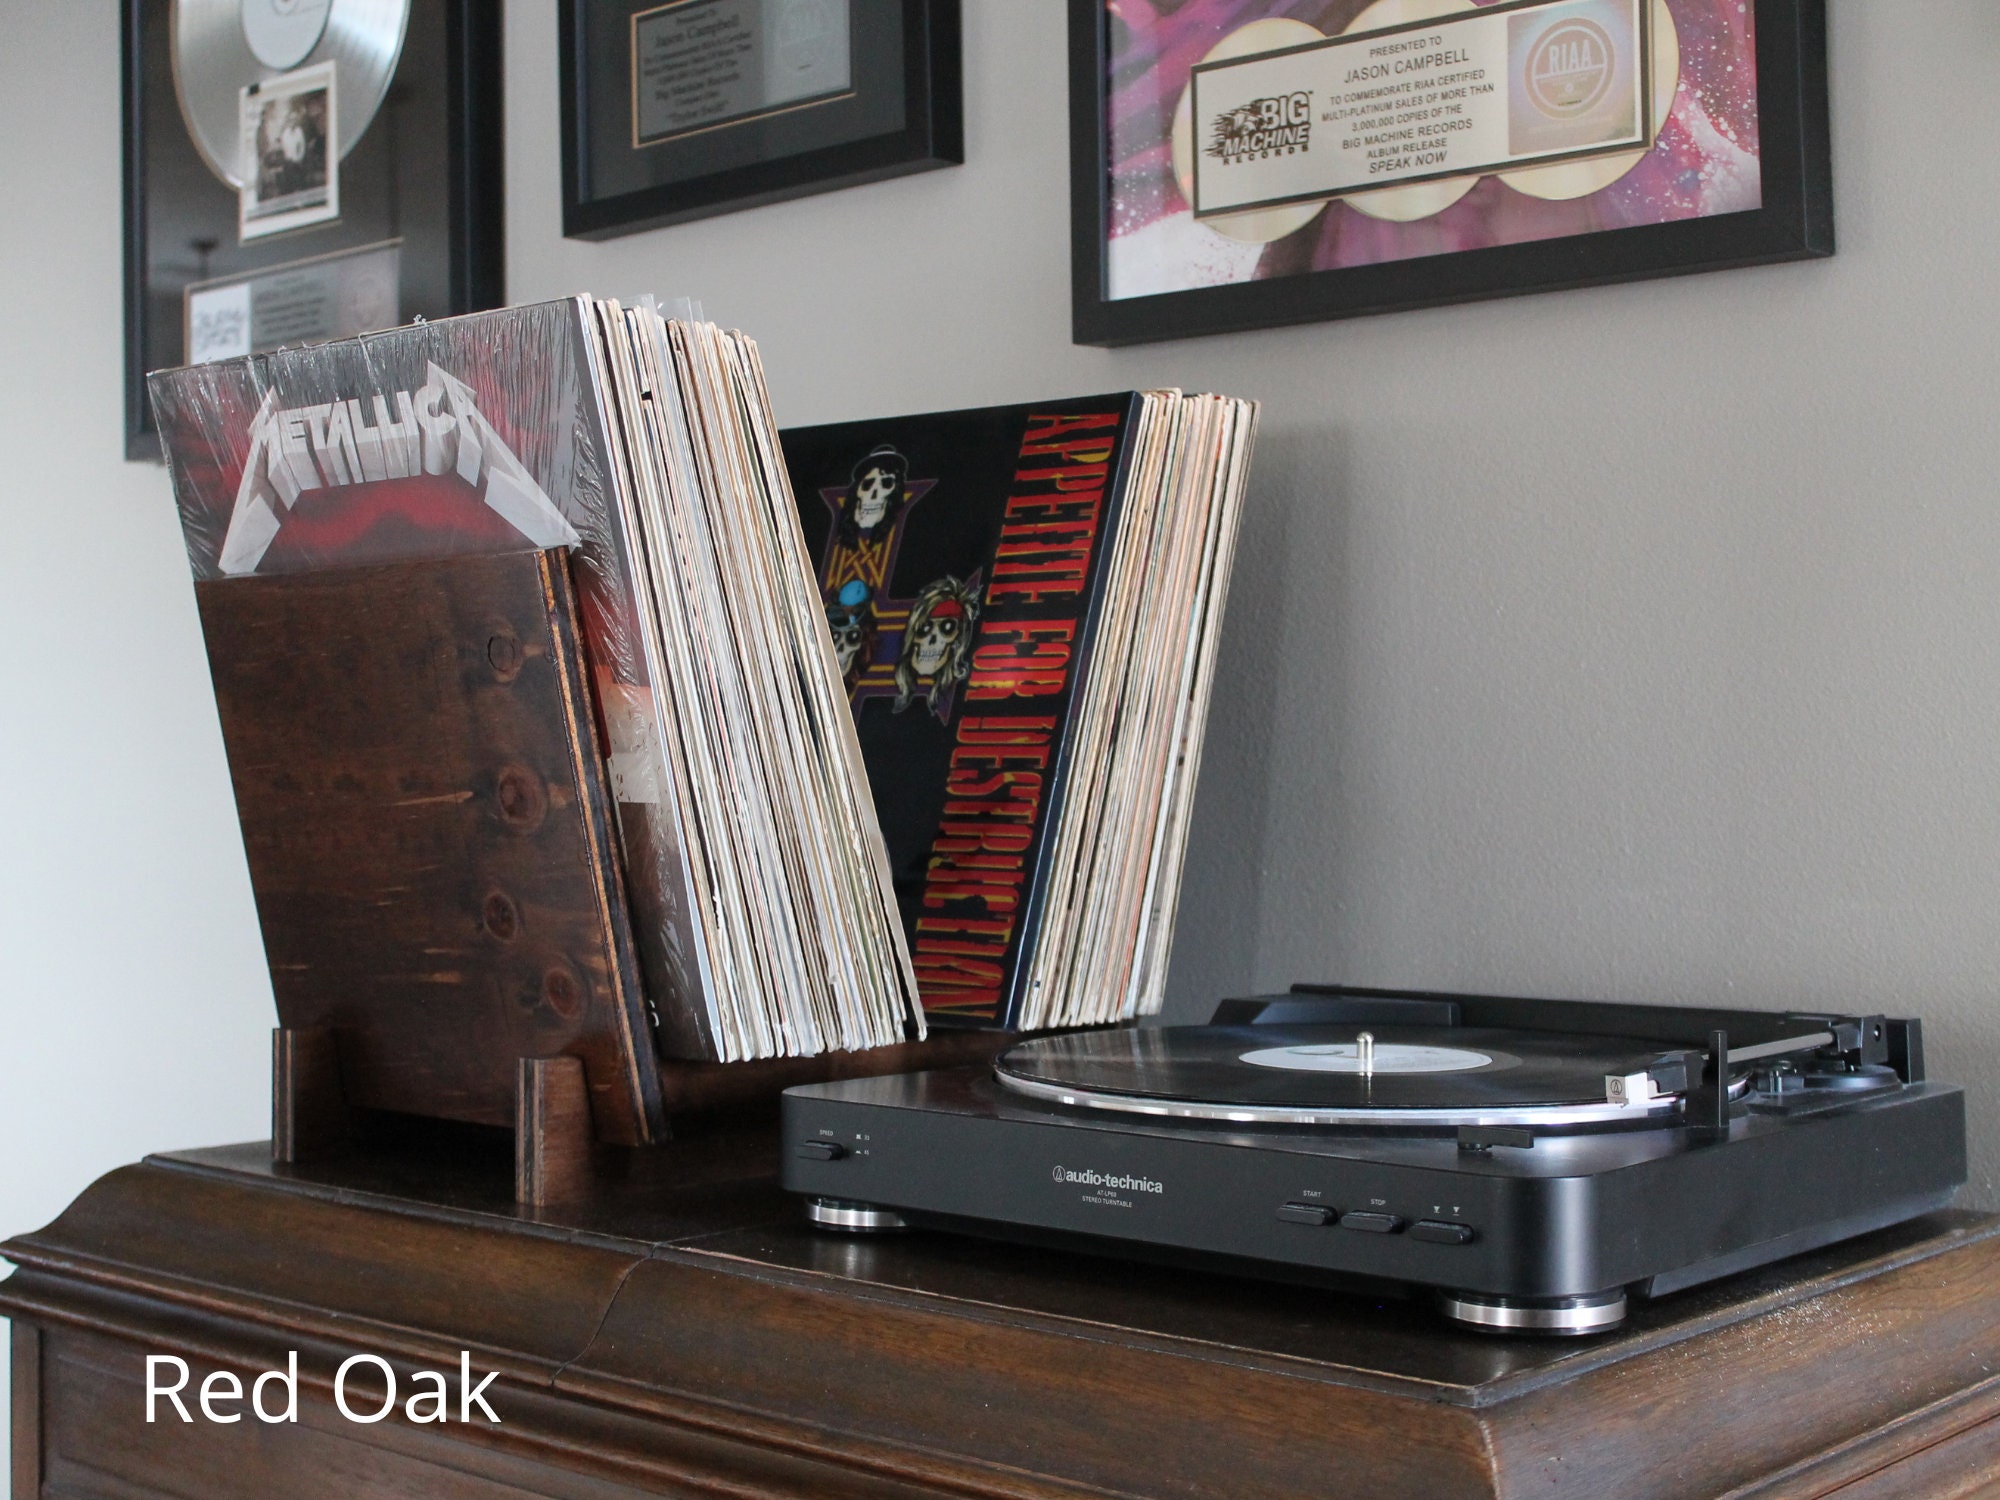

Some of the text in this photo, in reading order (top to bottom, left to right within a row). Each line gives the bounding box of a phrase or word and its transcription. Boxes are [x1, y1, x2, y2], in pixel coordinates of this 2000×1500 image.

[1370, 35, 1442, 58] PRESENTED TO
[1549, 39, 1593, 75] RIAA
[1344, 48, 1470, 84] JASON CAMPBELL
[1330, 69, 1485, 106] TO COMMEMORATE RIAA CERTIFIED
[1260, 91, 1310, 131] BIG
[1321, 83, 1495, 122] MULTI-PLATINUM SALES OF MORE THAN
[1352, 103, 1462, 132] 3,000,000 COPIES OF THE
[1222, 122, 1311, 157] MACHINE
[1342, 118, 1473, 150] BIG MACHINE RECORDS
[1367, 137, 1448, 159] ALBUM RELEASE
[1223, 143, 1309, 165] RECORDS
[1369, 151, 1448, 174] SPEAK NOW
[218, 360, 582, 574] METALLICA
[913, 412, 1120, 1019] APPETITE FOR DESTRUCTION
[819, 1129, 834, 1137] SPEED
[1066, 1169, 1163, 1193] audio-technica
[1303, 1190, 1322, 1198] START
[1082, 1195, 1133, 1208] STEREO TURNTABLE
[1370, 1198, 1387, 1206] STOP
